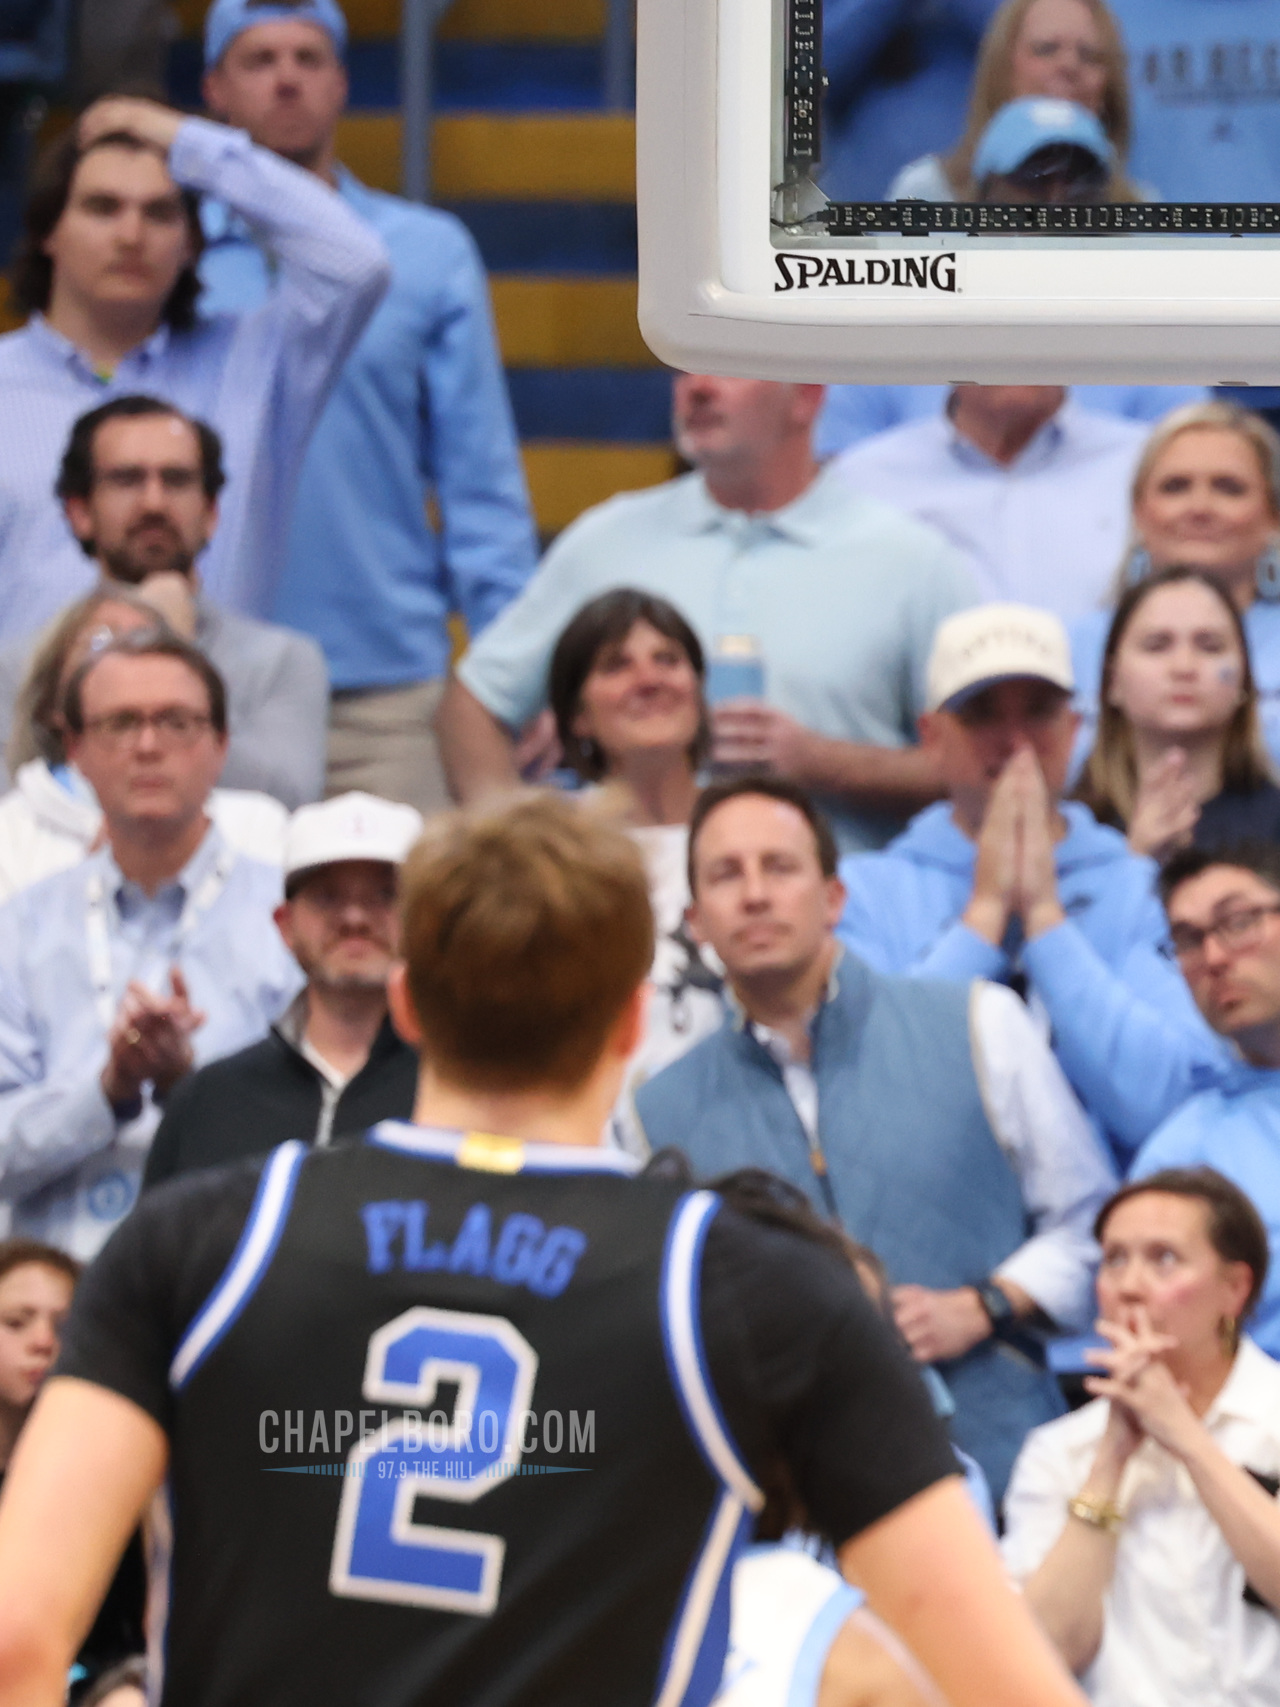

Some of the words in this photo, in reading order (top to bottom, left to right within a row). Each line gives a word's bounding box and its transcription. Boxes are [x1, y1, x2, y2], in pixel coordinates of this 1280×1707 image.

[775, 253, 956, 292] SPALDING
[360, 1198, 588, 1298] FLAGG
[329, 1305, 539, 1618] 2
